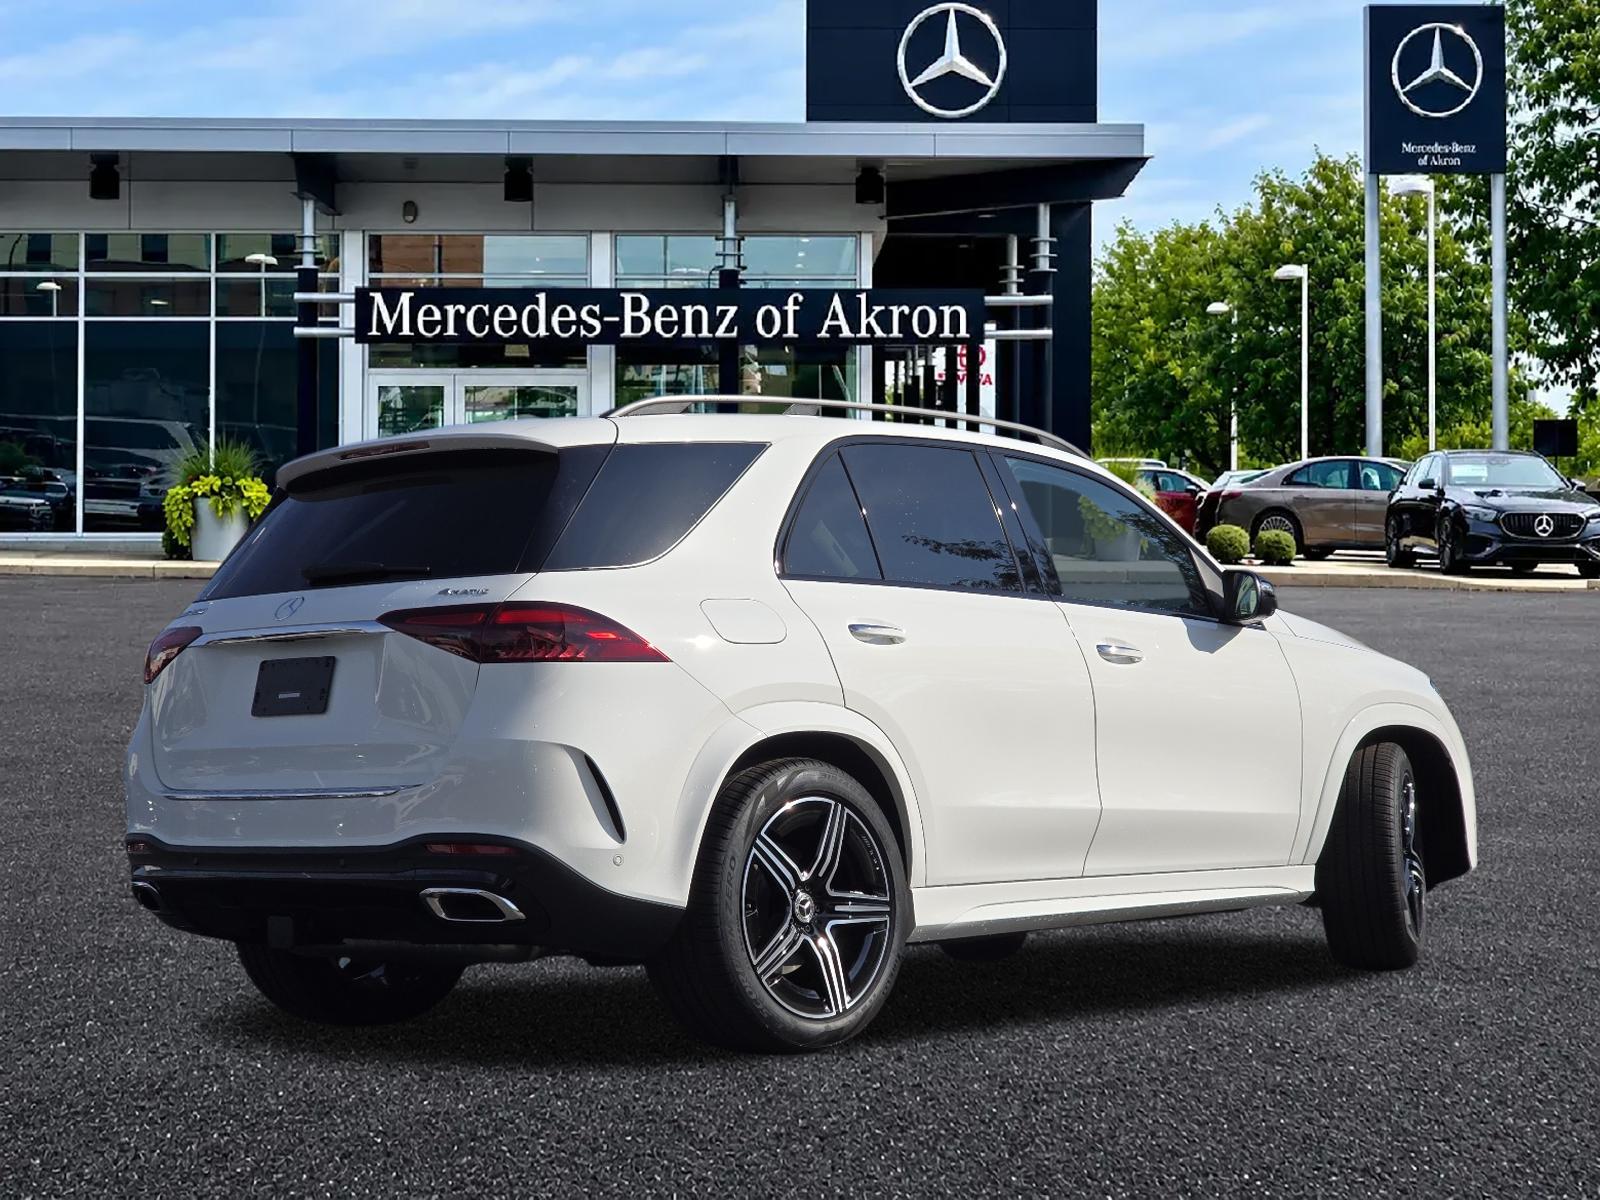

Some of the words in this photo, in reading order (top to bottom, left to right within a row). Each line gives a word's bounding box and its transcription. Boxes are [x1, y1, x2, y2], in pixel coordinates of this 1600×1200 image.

[1401, 141, 1476, 153] Mercedes-Benz
[1417, 154, 1428, 166] of
[1430, 154, 1461, 166] Akron
[367, 291, 738, 338] Mercedes-Benz
[755, 292, 804, 338] of
[816, 291, 970, 338] Akron
[724, 855, 737, 915] ZERO
